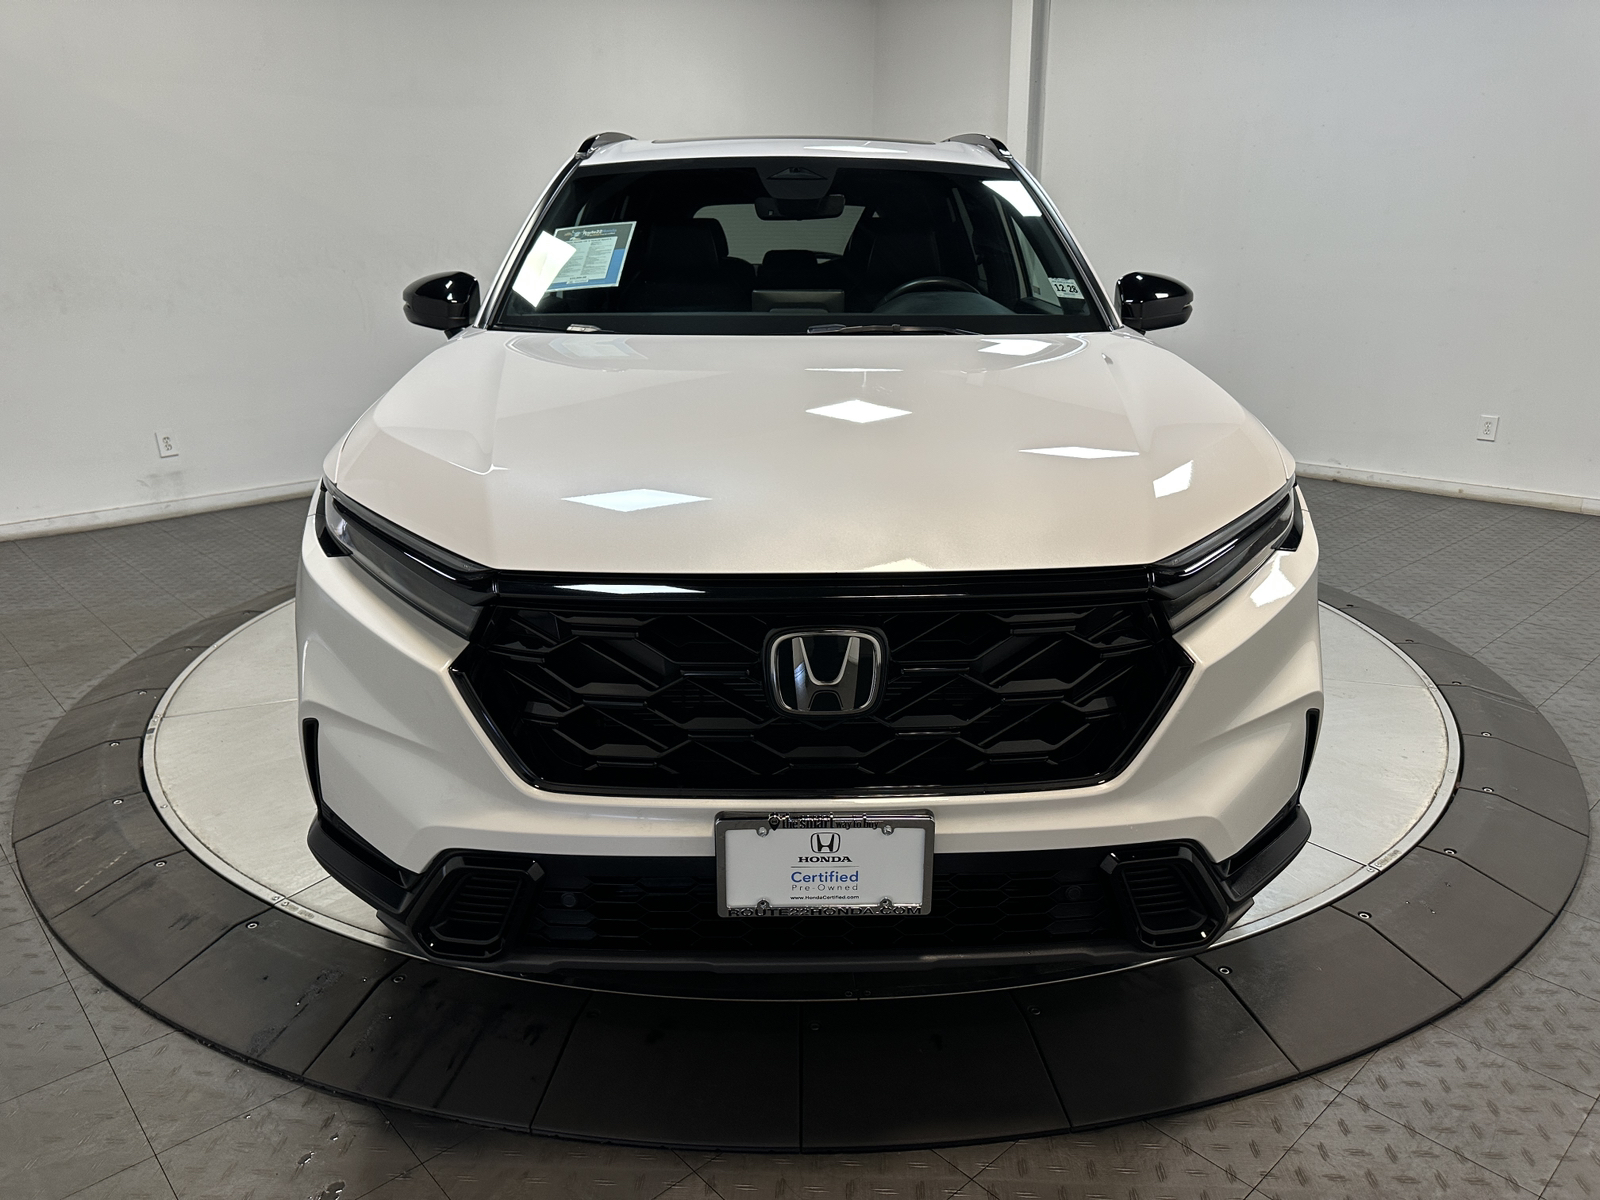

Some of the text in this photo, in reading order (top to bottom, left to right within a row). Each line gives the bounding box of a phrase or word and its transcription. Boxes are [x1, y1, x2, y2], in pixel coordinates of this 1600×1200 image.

[1054, 284, 1066, 292] 12
[782, 817, 879, 830] the smart way to buy
[790, 870, 859, 883] Certified
[791, 883, 858, 891] Pre-Owned
[728, 906, 922, 917] ROUTE22HONDA.COM
